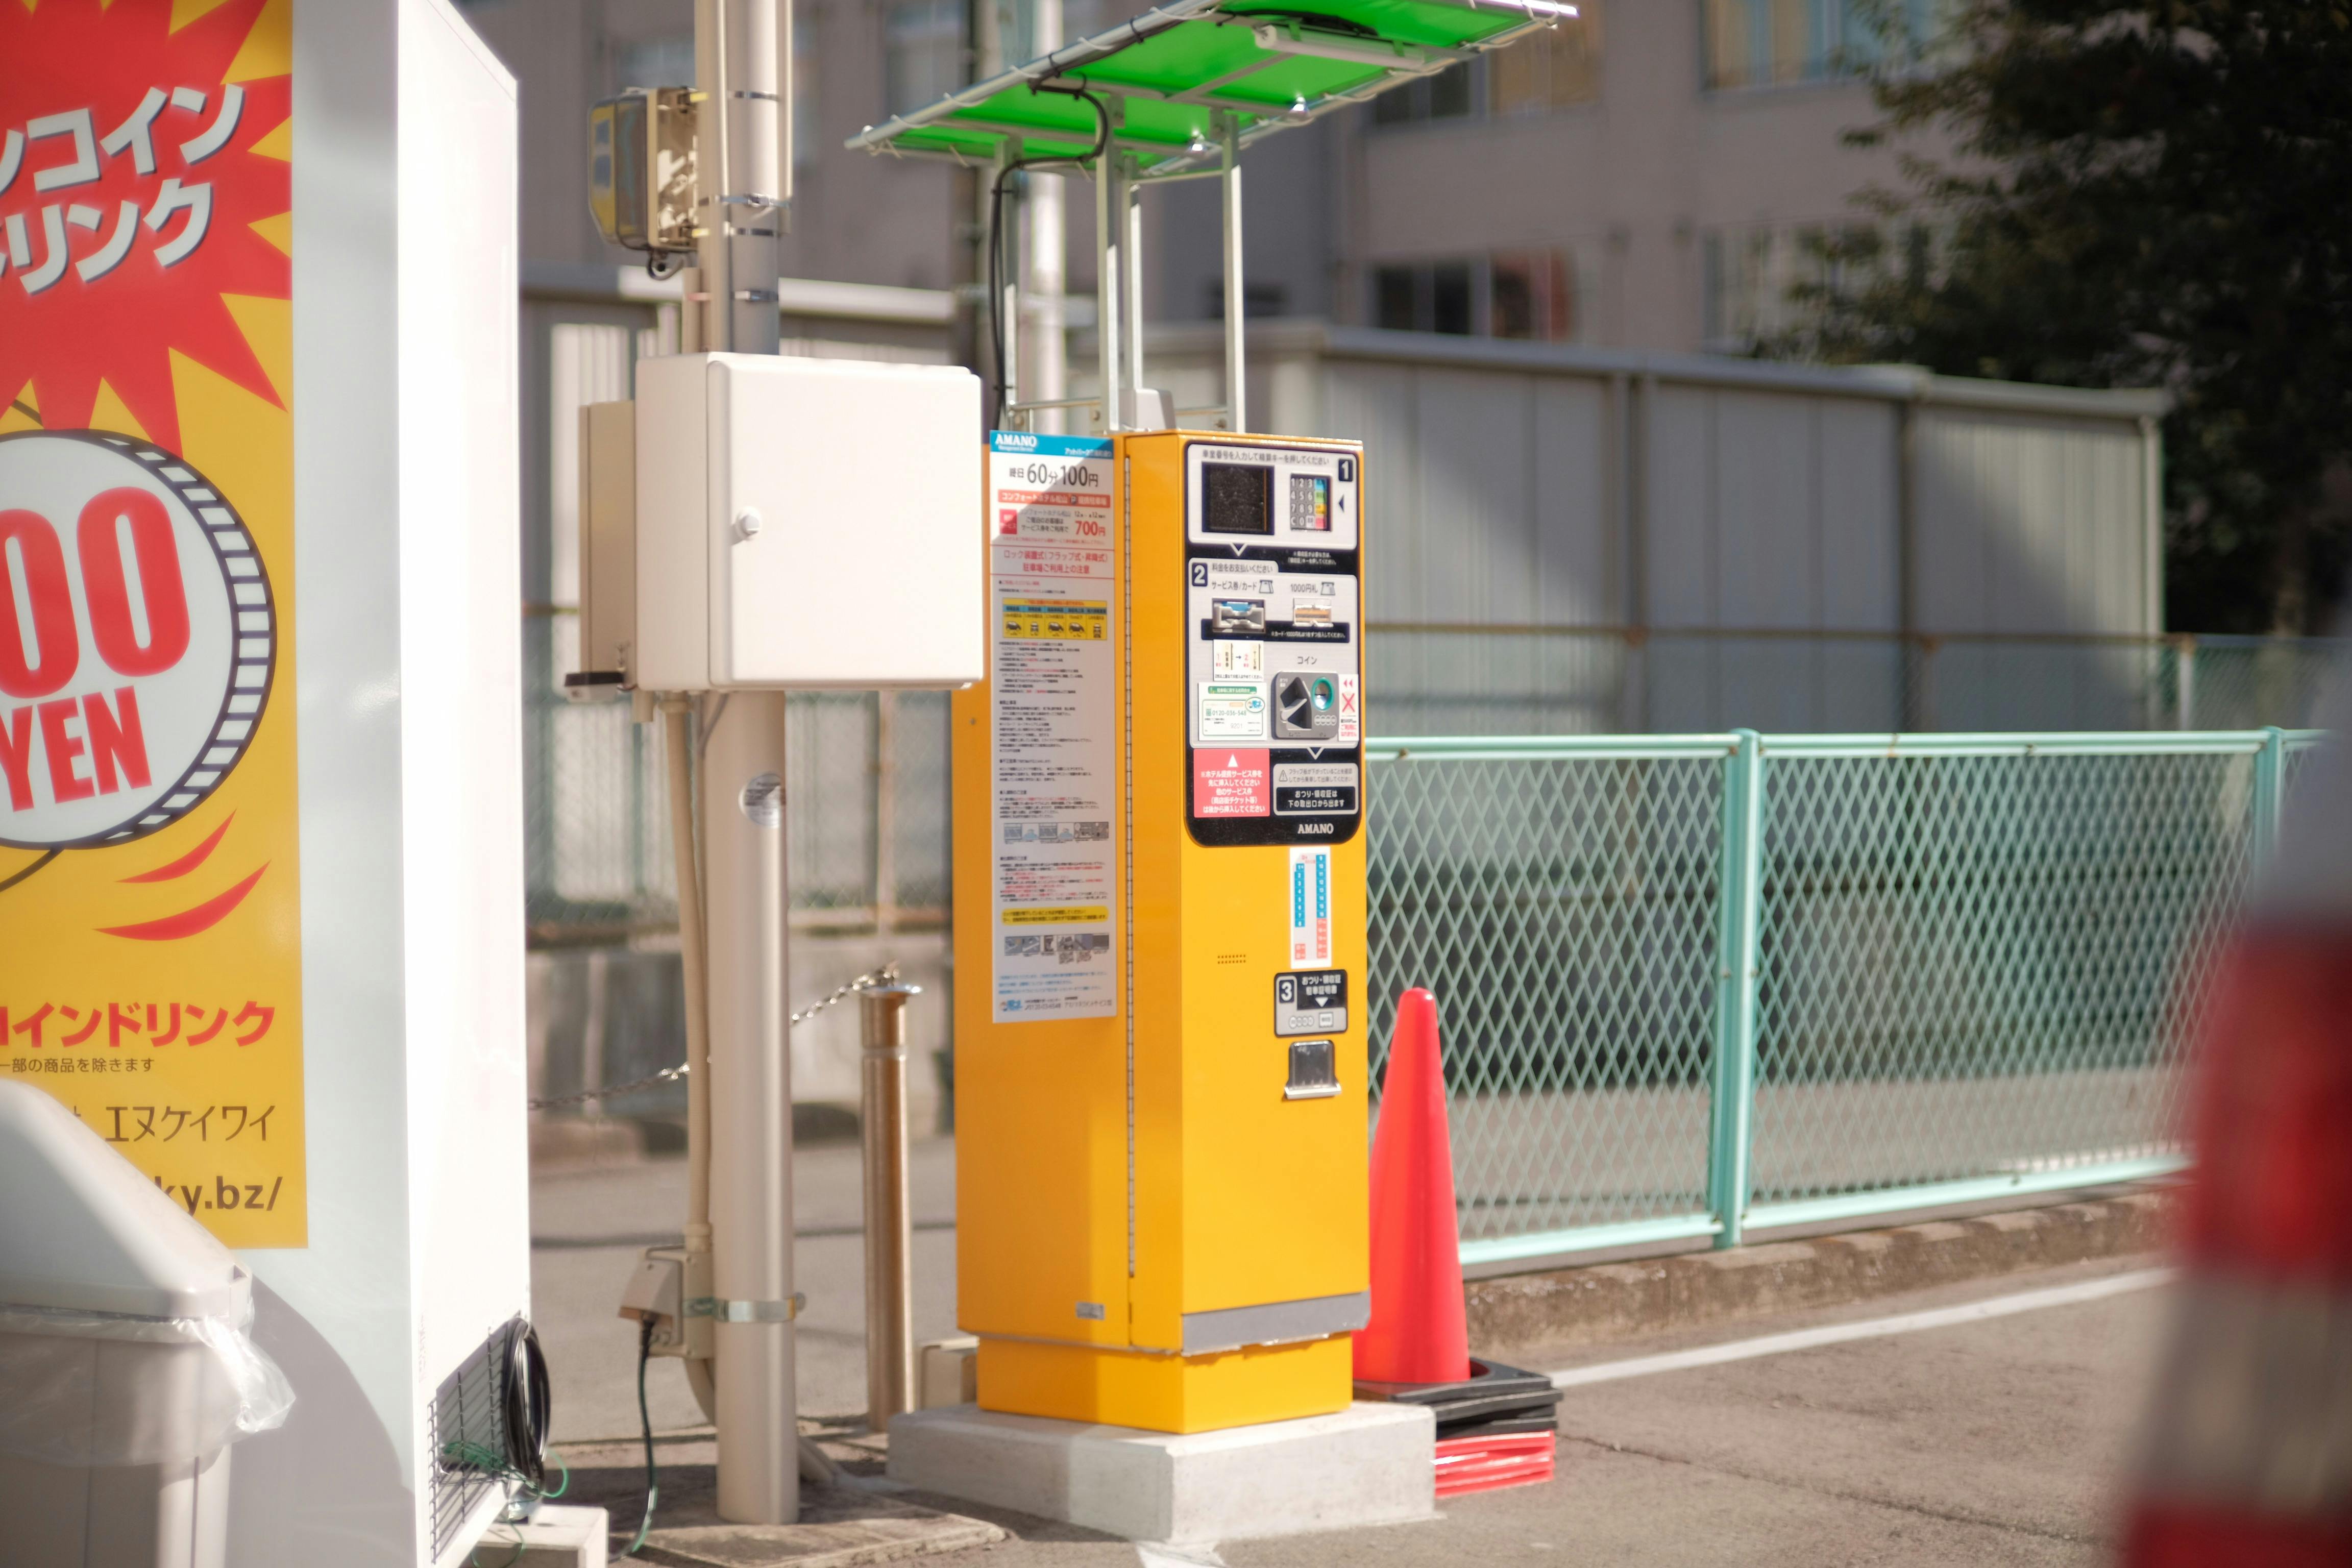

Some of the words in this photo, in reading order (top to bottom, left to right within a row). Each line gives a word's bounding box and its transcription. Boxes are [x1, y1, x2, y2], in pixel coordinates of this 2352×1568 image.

[995, 434, 1037, 447] AMANO
[1009, 468, 1024, 478] 終日
[1027, 463, 1058, 485] 60分
[1060, 465, 1098, 487] 100円
[1341, 460, 1349, 480] 1
[1299, 478, 1304, 487] 2
[1075, 521, 1106, 536] 700円
[1212, 562, 1273, 573] 料金をお支払いください
[1194, 565, 1205, 584] 2
[1211, 580, 1257, 591] サービス券/カード
[1290, 583, 1318, 594] 1000円札
[1297, 656, 1317, 665] コイン
[0, 685, 152, 812] YEN
[1288, 799, 1345, 808] 下の取出口から出ます
[1297, 823, 1334, 835] AMANO
[1281, 981, 1292, 1001] 3
[105, 1105, 276, 1142] エヌケイワイ
